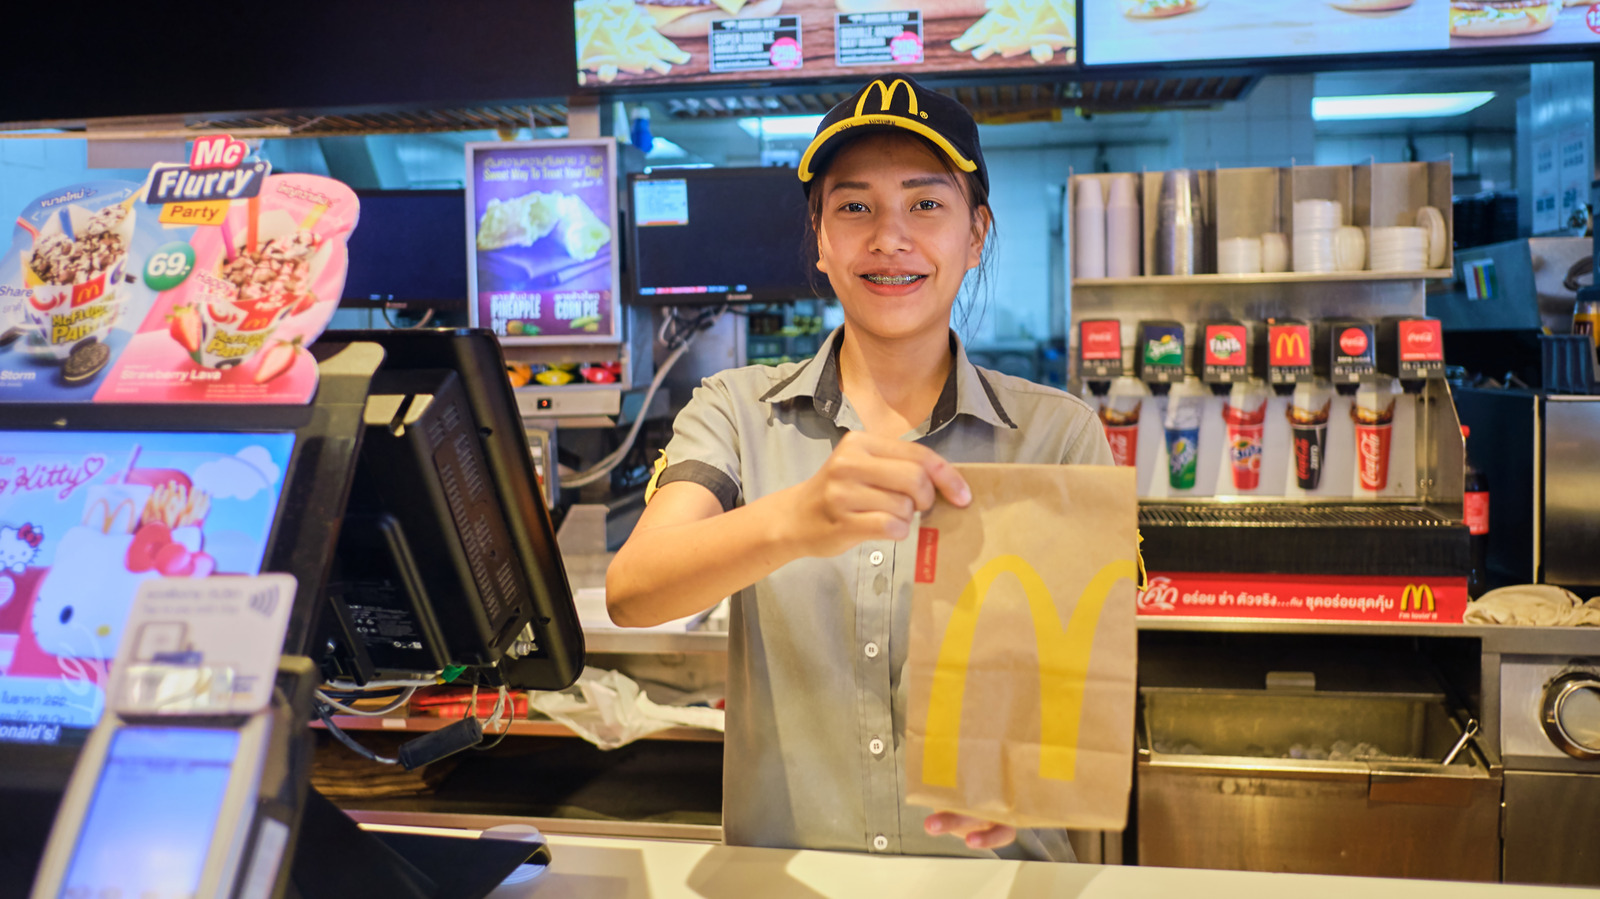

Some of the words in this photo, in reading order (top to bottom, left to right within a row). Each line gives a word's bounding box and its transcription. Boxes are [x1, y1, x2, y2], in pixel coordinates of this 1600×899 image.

[194, 138, 242, 166] Mc
[157, 169, 254, 198] Flurry
[170, 205, 220, 221] Party
[491, 300, 541, 319] PINEAPPLE
[1, 369, 36, 380] Storm
[120, 369, 188, 382] Strawberry
[190, 369, 222, 380] Lava
[11, 460, 94, 499] Kitty
[1183, 590, 1216, 606] อร่อย
